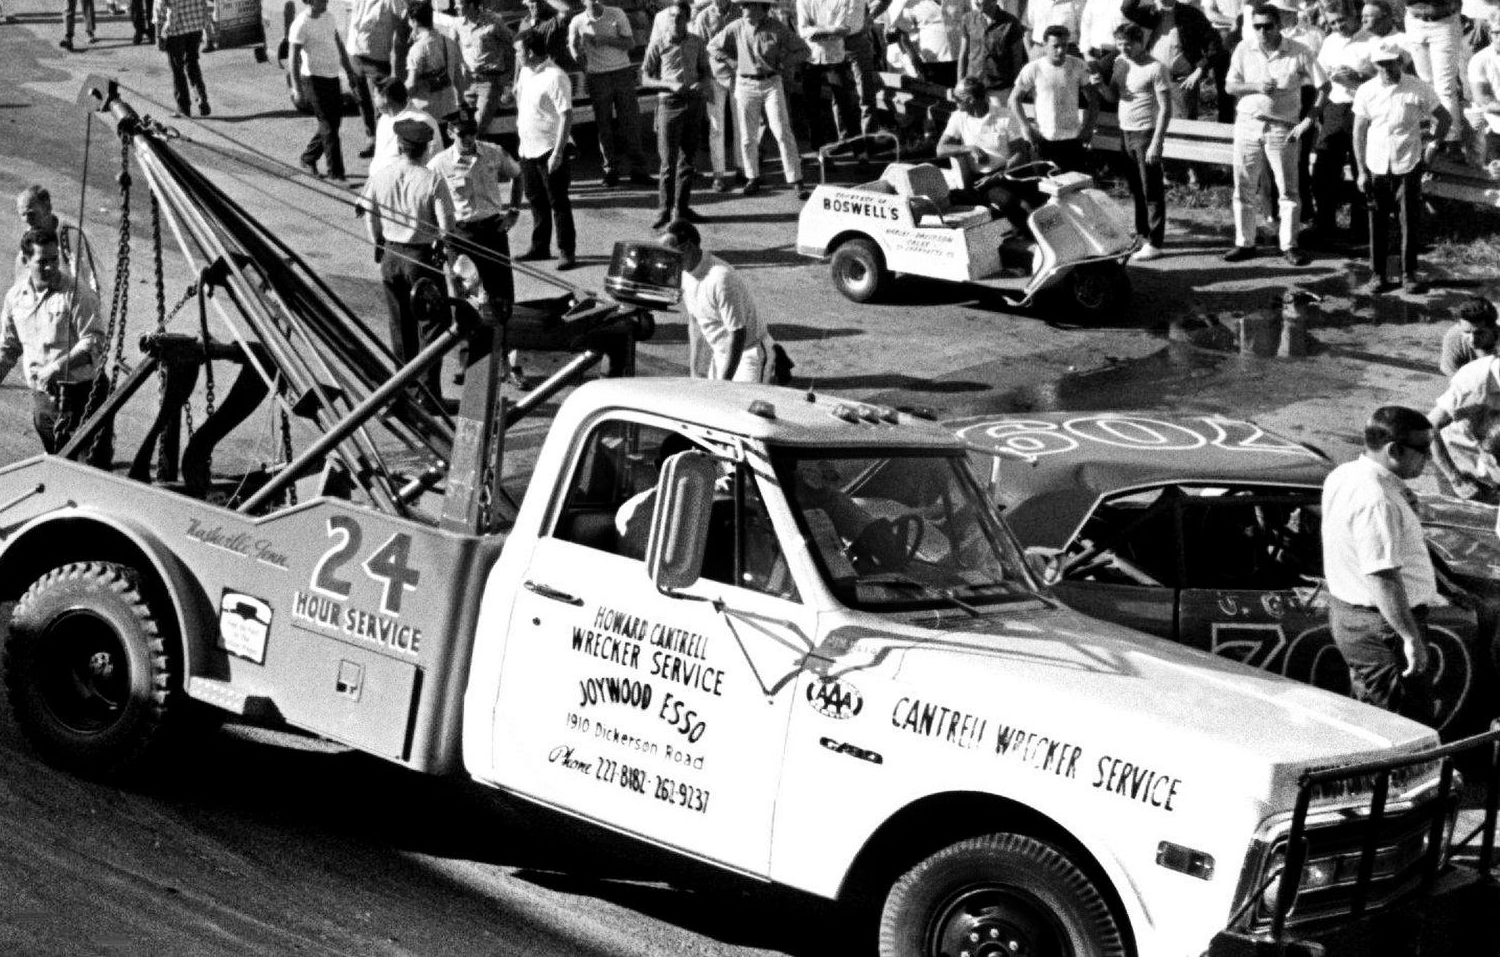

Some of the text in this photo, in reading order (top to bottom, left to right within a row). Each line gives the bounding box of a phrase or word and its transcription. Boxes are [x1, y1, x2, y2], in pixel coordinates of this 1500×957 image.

[823, 198, 900, 221] BOSWELL'S
[310, 514, 421, 618] 24
[293, 592, 422, 655] HOUR SERVICE
[594, 606, 709, 661] HOWARD CANTRELL
[572, 626, 725, 696] WRECKER SERVICE
[579, 677, 706, 744] JOYWOOD ESSO
[816, 682, 852, 715] AAA
[548, 744, 593, 775] Phone
[566, 712, 705, 770] 1910 Dickerson Road
[892, 696, 1182, 812] CANTRELL WRECKER SERVICE
